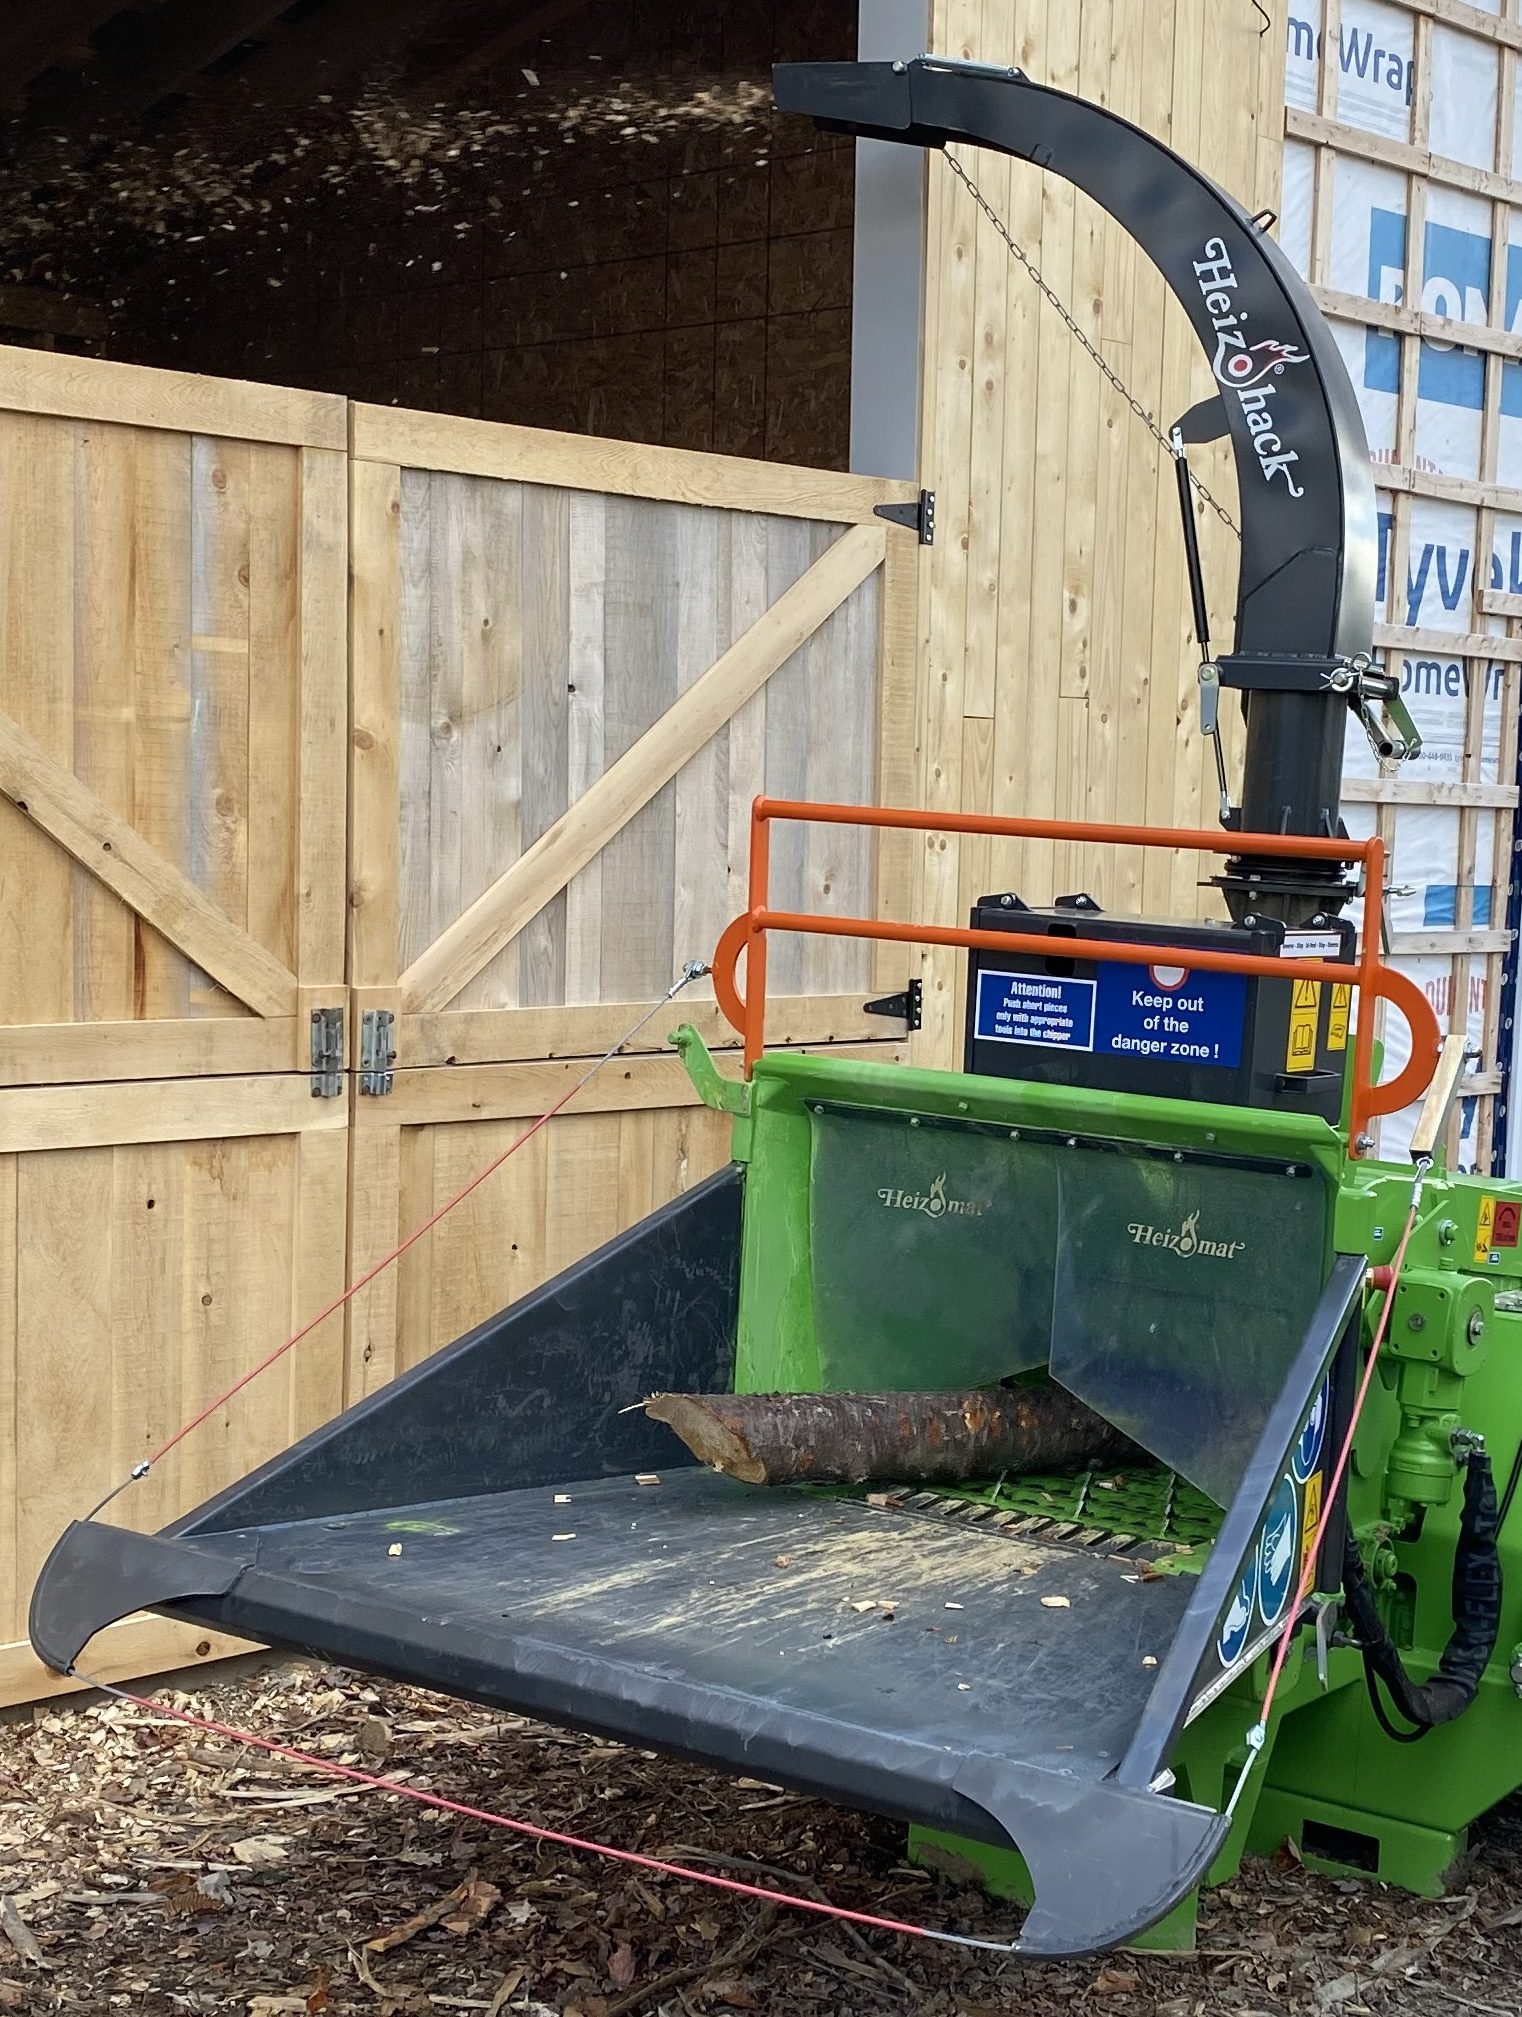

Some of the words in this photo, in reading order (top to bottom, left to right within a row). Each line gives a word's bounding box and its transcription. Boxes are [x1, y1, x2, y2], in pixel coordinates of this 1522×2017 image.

[1010, 981, 1062, 999] Attention!
[1003, 998, 1021, 1009] Push
[1022, 1000, 1043, 1011] short
[1043, 1003, 1068, 1014] pieces
[1132, 990, 1173, 1012] Keep
[1177, 997, 1204, 1012] out
[996, 1011, 1012, 1023] only
[1012, 1013, 1029, 1023] with
[1029, 1015, 1074, 1028] appropriate
[1143, 1015, 1160, 1031] of
[1163, 1016, 1189, 1033] the
[994, 1024, 1013, 1035] tools
[1013, 1025, 1028, 1037] into
[1029, 1027, 1042, 1037] the
[1042, 1029, 1071, 1041] chipper
[1111, 1033, 1167, 1055] danger
[1170, 1042, 1210, 1058] zone
[1127, 1209, 1246, 1259] Heizomat
